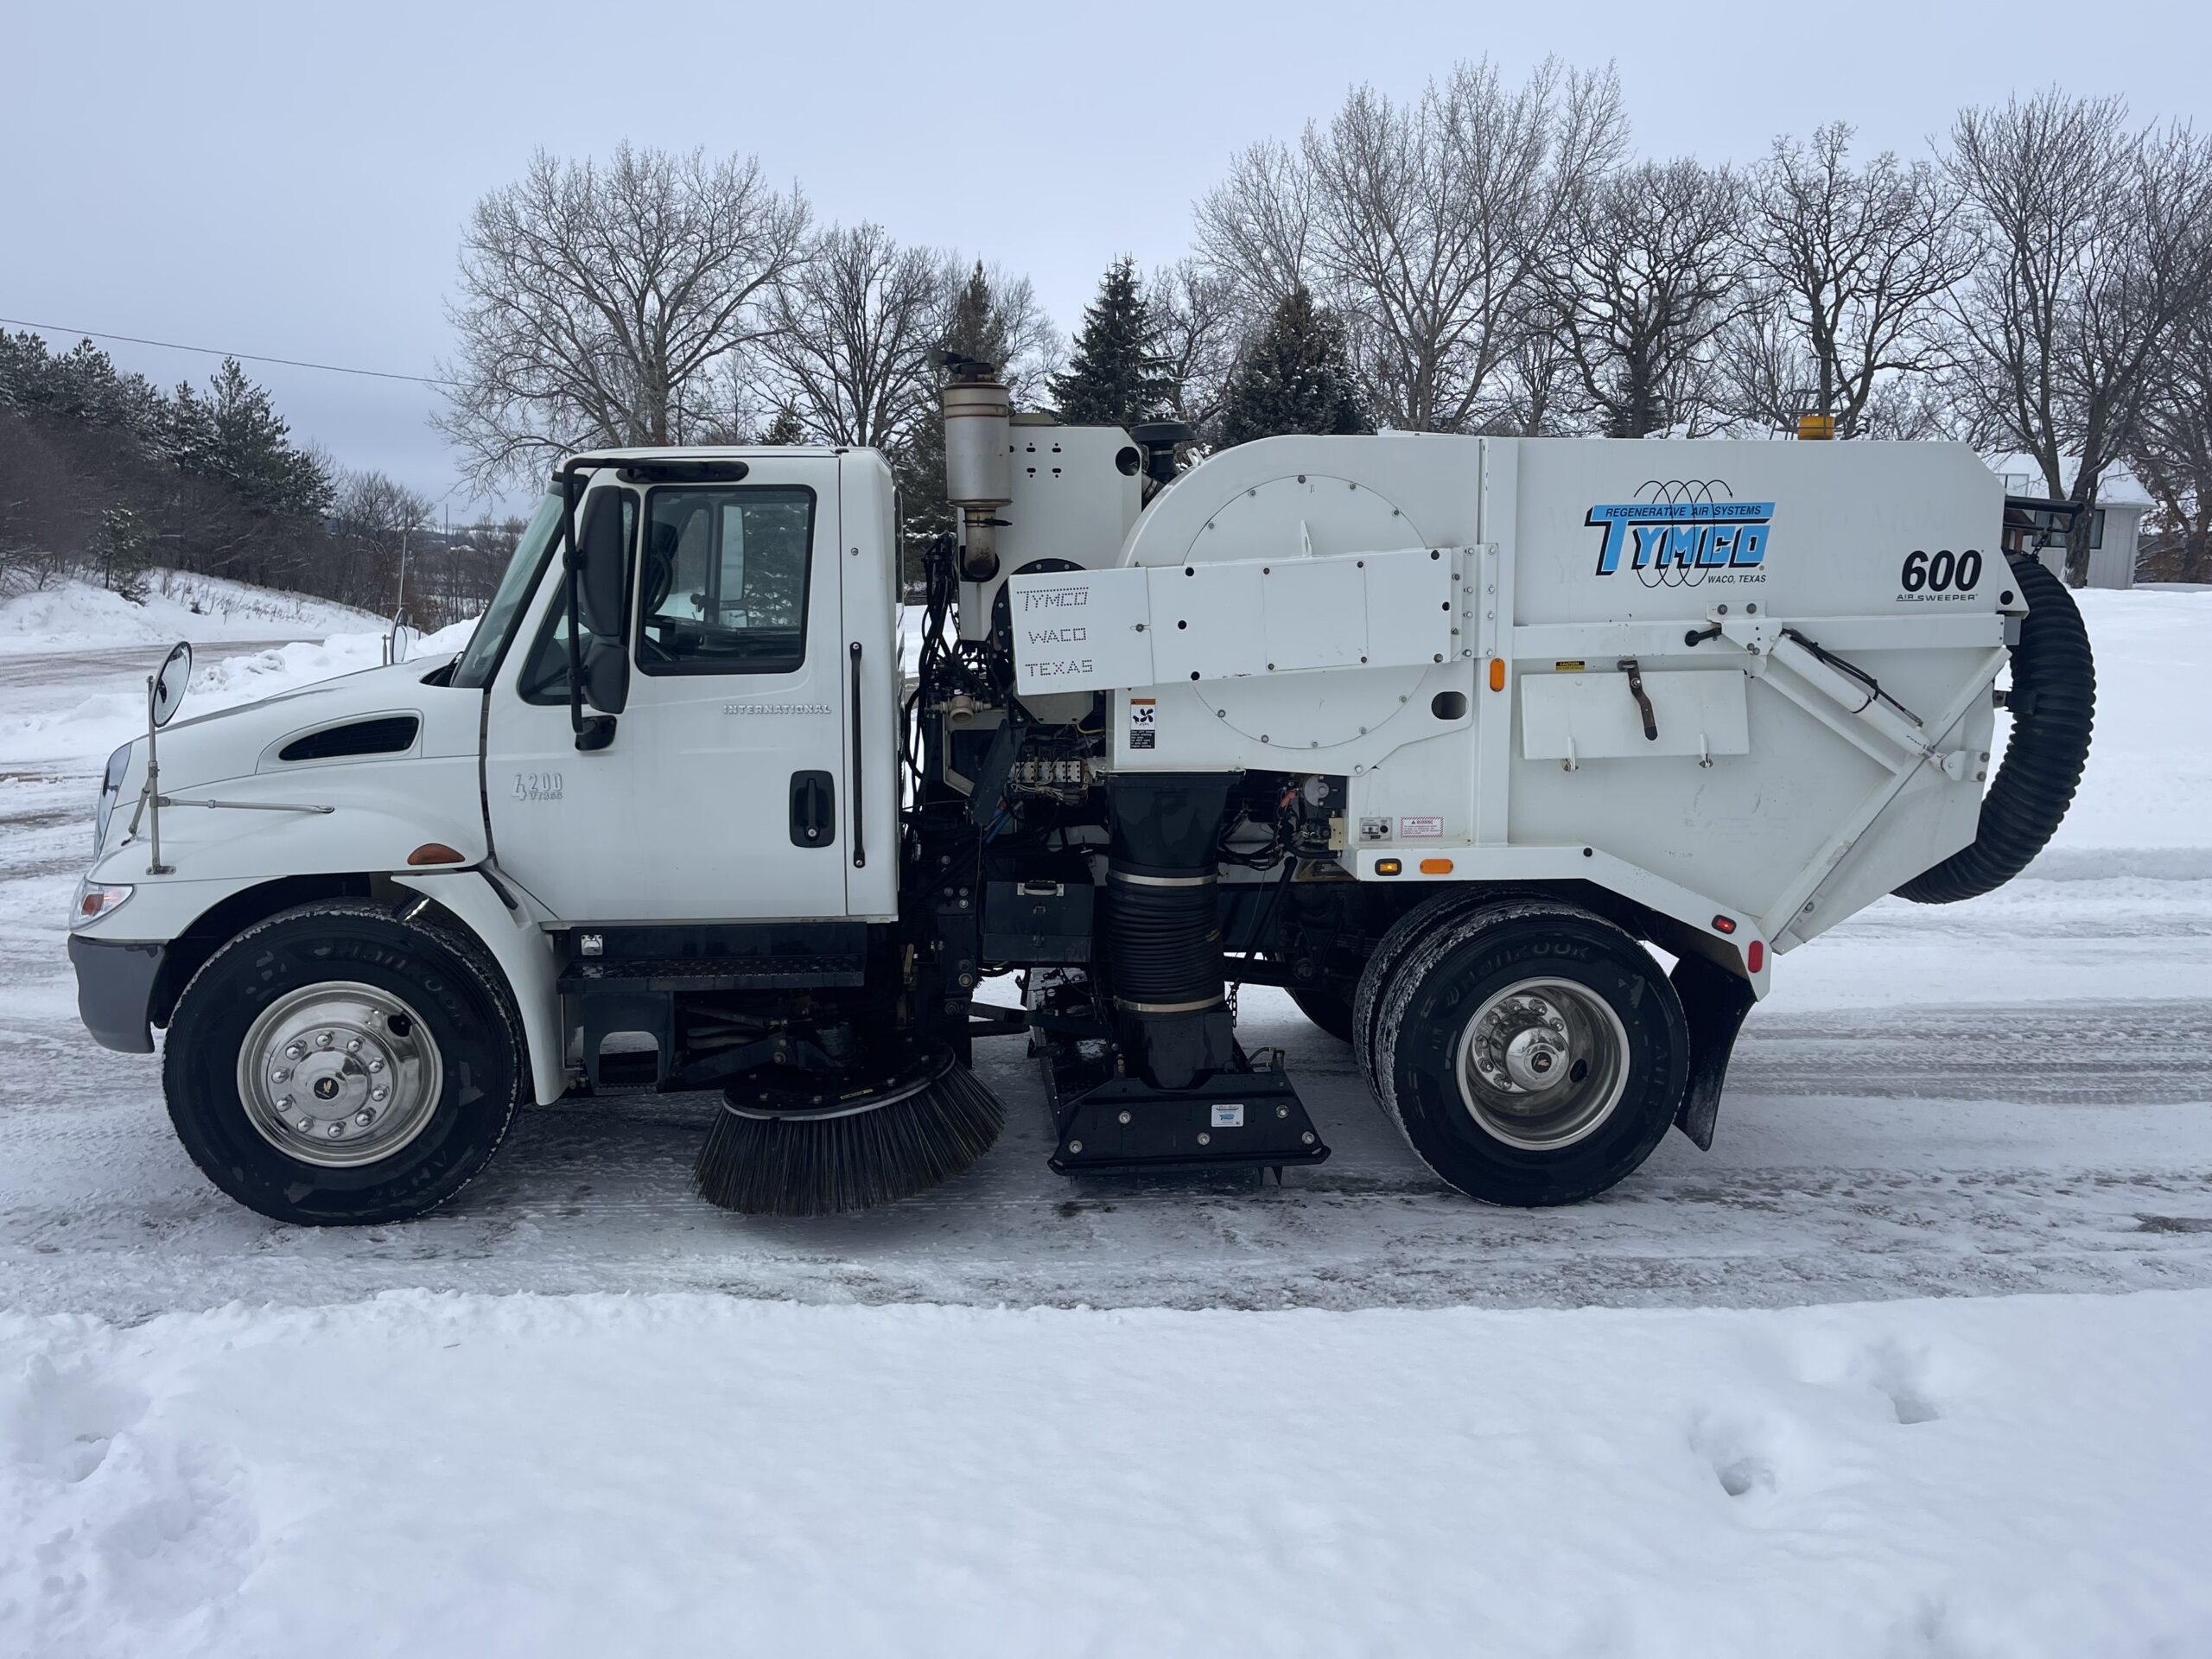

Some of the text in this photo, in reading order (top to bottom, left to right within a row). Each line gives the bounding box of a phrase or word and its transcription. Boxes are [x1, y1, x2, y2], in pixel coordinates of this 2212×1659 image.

[1605, 505, 1762, 518] REGENERATIVE AIR SYSTEMS
[1584, 502, 1776, 576] TYMCO
[1707, 575, 1766, 584] WACO, TEXAS
[1902, 550, 1982, 592] 600
[1016, 587, 1090, 612] TYMCO
[1028, 627, 1087, 645] WACO
[1025, 659, 1093, 677] TEXAS
[723, 704, 831, 715] INTERNATIONAL
[512, 772, 563, 801] 4200
